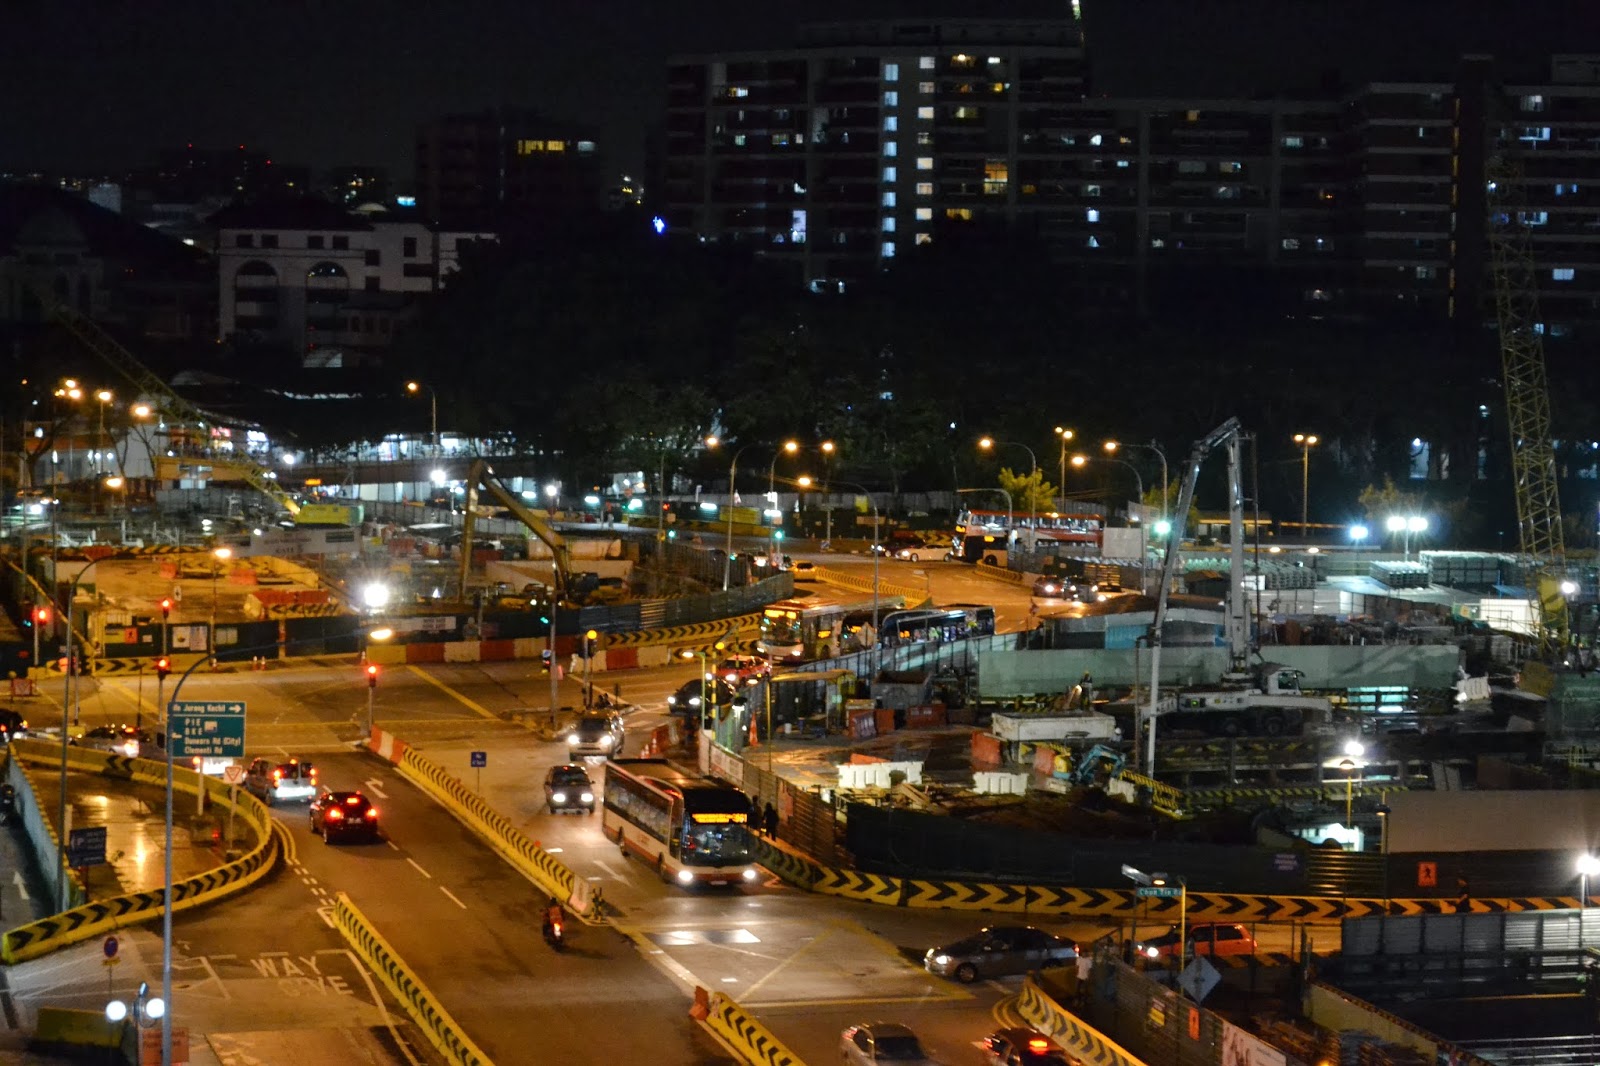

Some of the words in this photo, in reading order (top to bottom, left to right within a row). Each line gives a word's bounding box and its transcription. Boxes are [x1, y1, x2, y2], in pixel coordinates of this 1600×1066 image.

[183, 704, 205, 714] Jurong
[185, 718, 201, 726] PIE
[184, 746, 212, 755] Clementi
[214, 746, 223, 755] Rd
[250, 956, 321, 977] WAY
[278, 975, 354, 997] GVE
